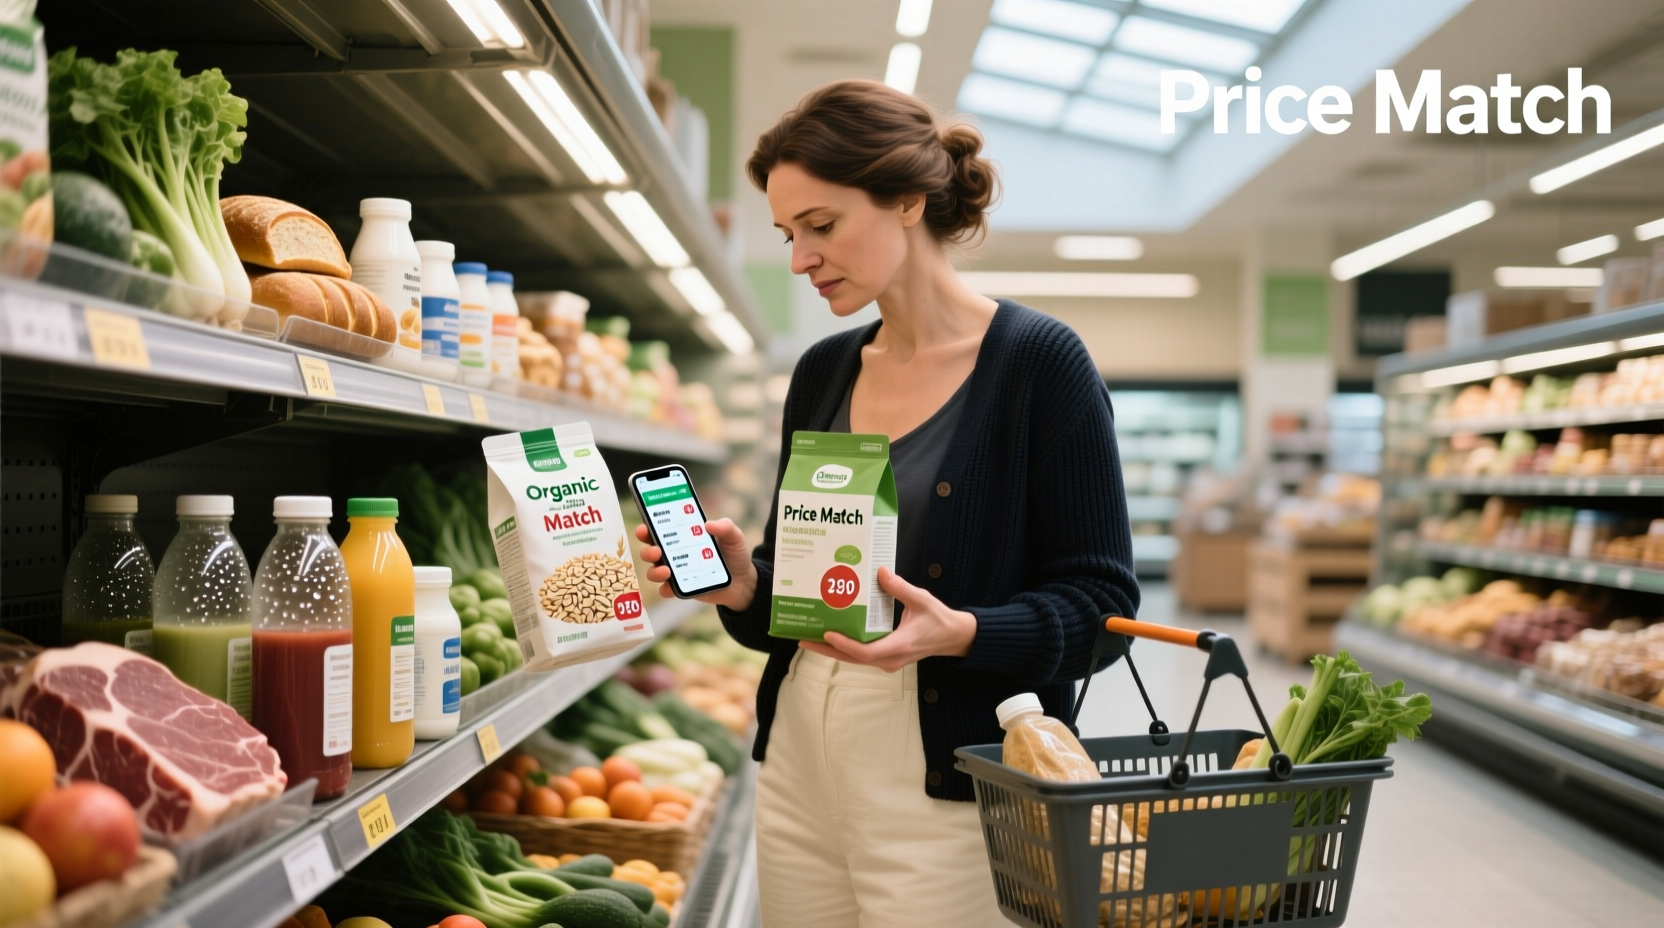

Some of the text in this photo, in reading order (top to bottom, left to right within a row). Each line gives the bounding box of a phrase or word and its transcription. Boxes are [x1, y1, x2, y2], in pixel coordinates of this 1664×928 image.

[526, 477, 600, 503] Organic
[543, 505, 603, 533] Match
[784, 504, 863, 526] Price Match
